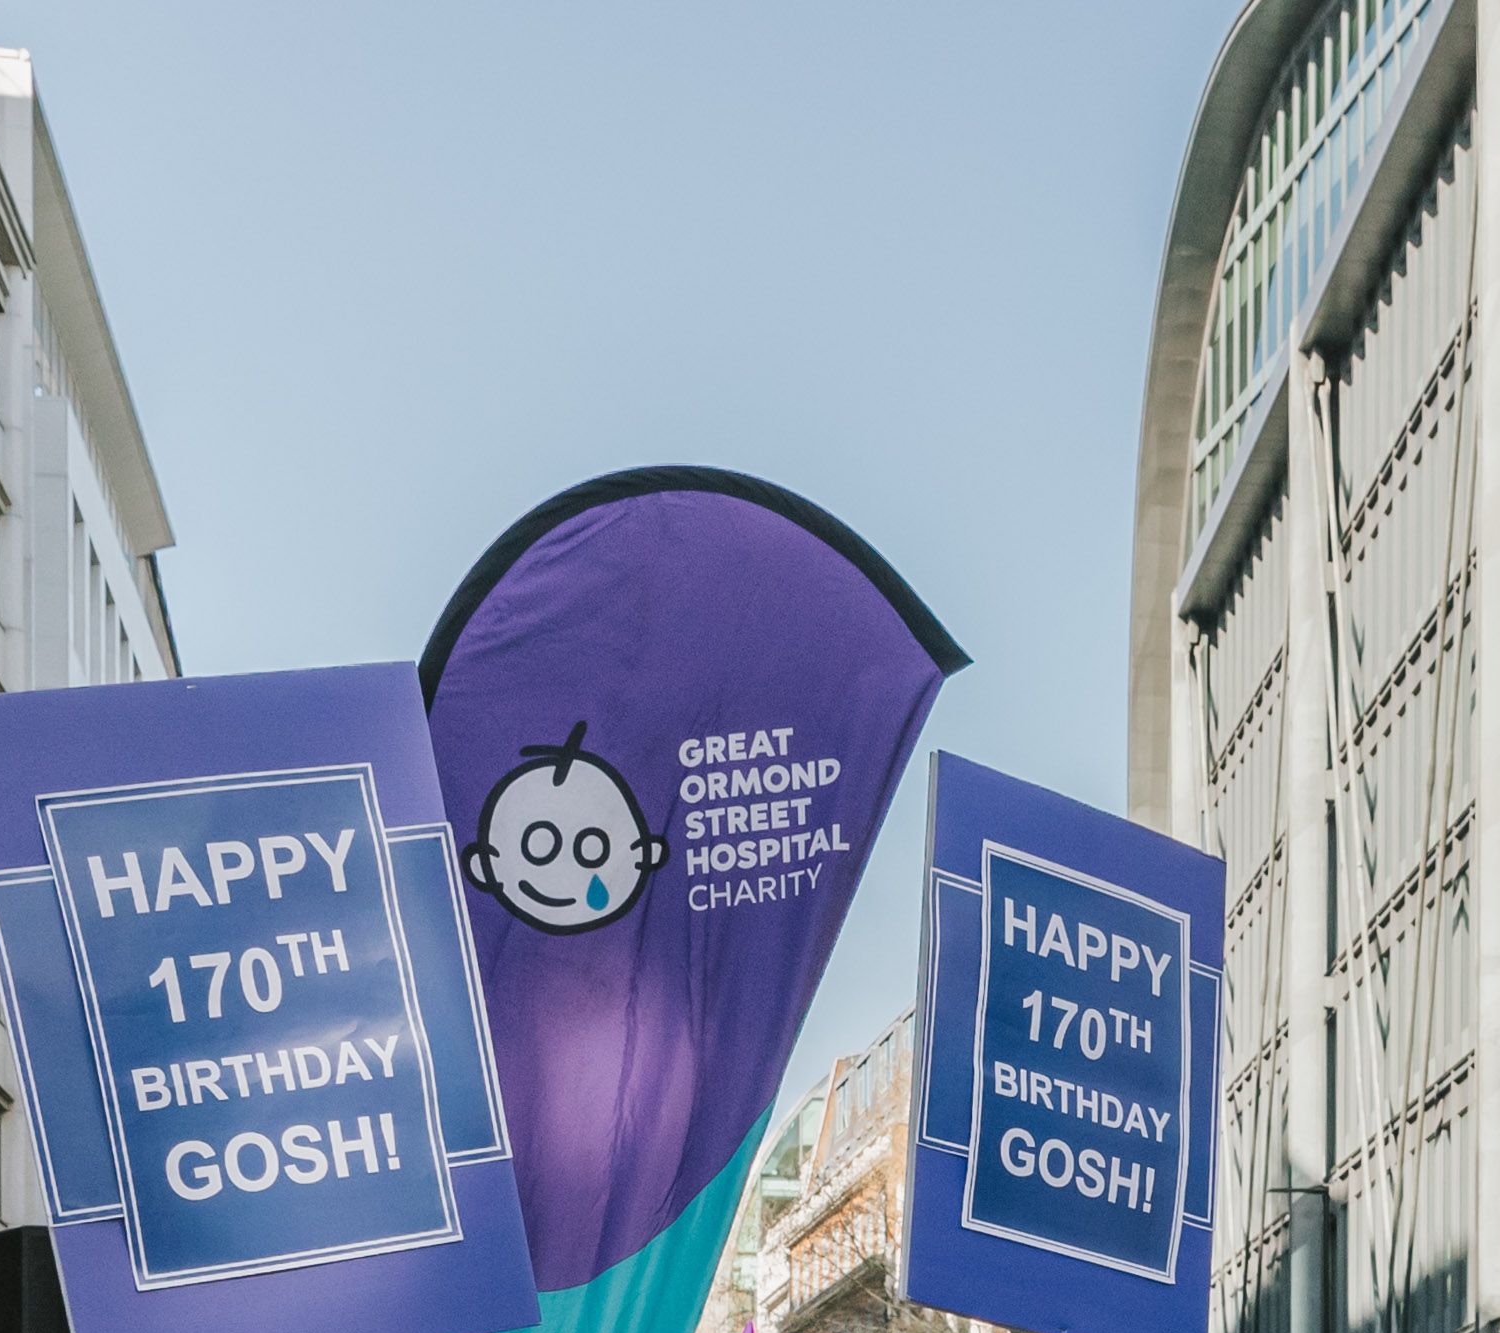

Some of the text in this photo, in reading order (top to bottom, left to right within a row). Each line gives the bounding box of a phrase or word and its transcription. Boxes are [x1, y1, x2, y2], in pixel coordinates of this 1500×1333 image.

[679, 728, 793, 767] GREAT
[680, 759, 840, 803] ORMOND
[686, 798, 811, 839] STREET
[687, 824, 849, 875] HOSPITAL
[87, 829, 355, 917] HAPPY
[689, 863, 822, 911] CHARITY
[150, 929, 350, 1022] 170TH
[1005, 905, 1171, 996] HAPPY
[1023, 990, 1151, 1060] 170TH
[131, 1034, 401, 1111] BIRTHDAY
[995, 1061, 1170, 1142] BIRTHDAY
[165, 1113, 400, 1200] GOSH!
[1001, 1128, 1155, 1213] GOSH!
